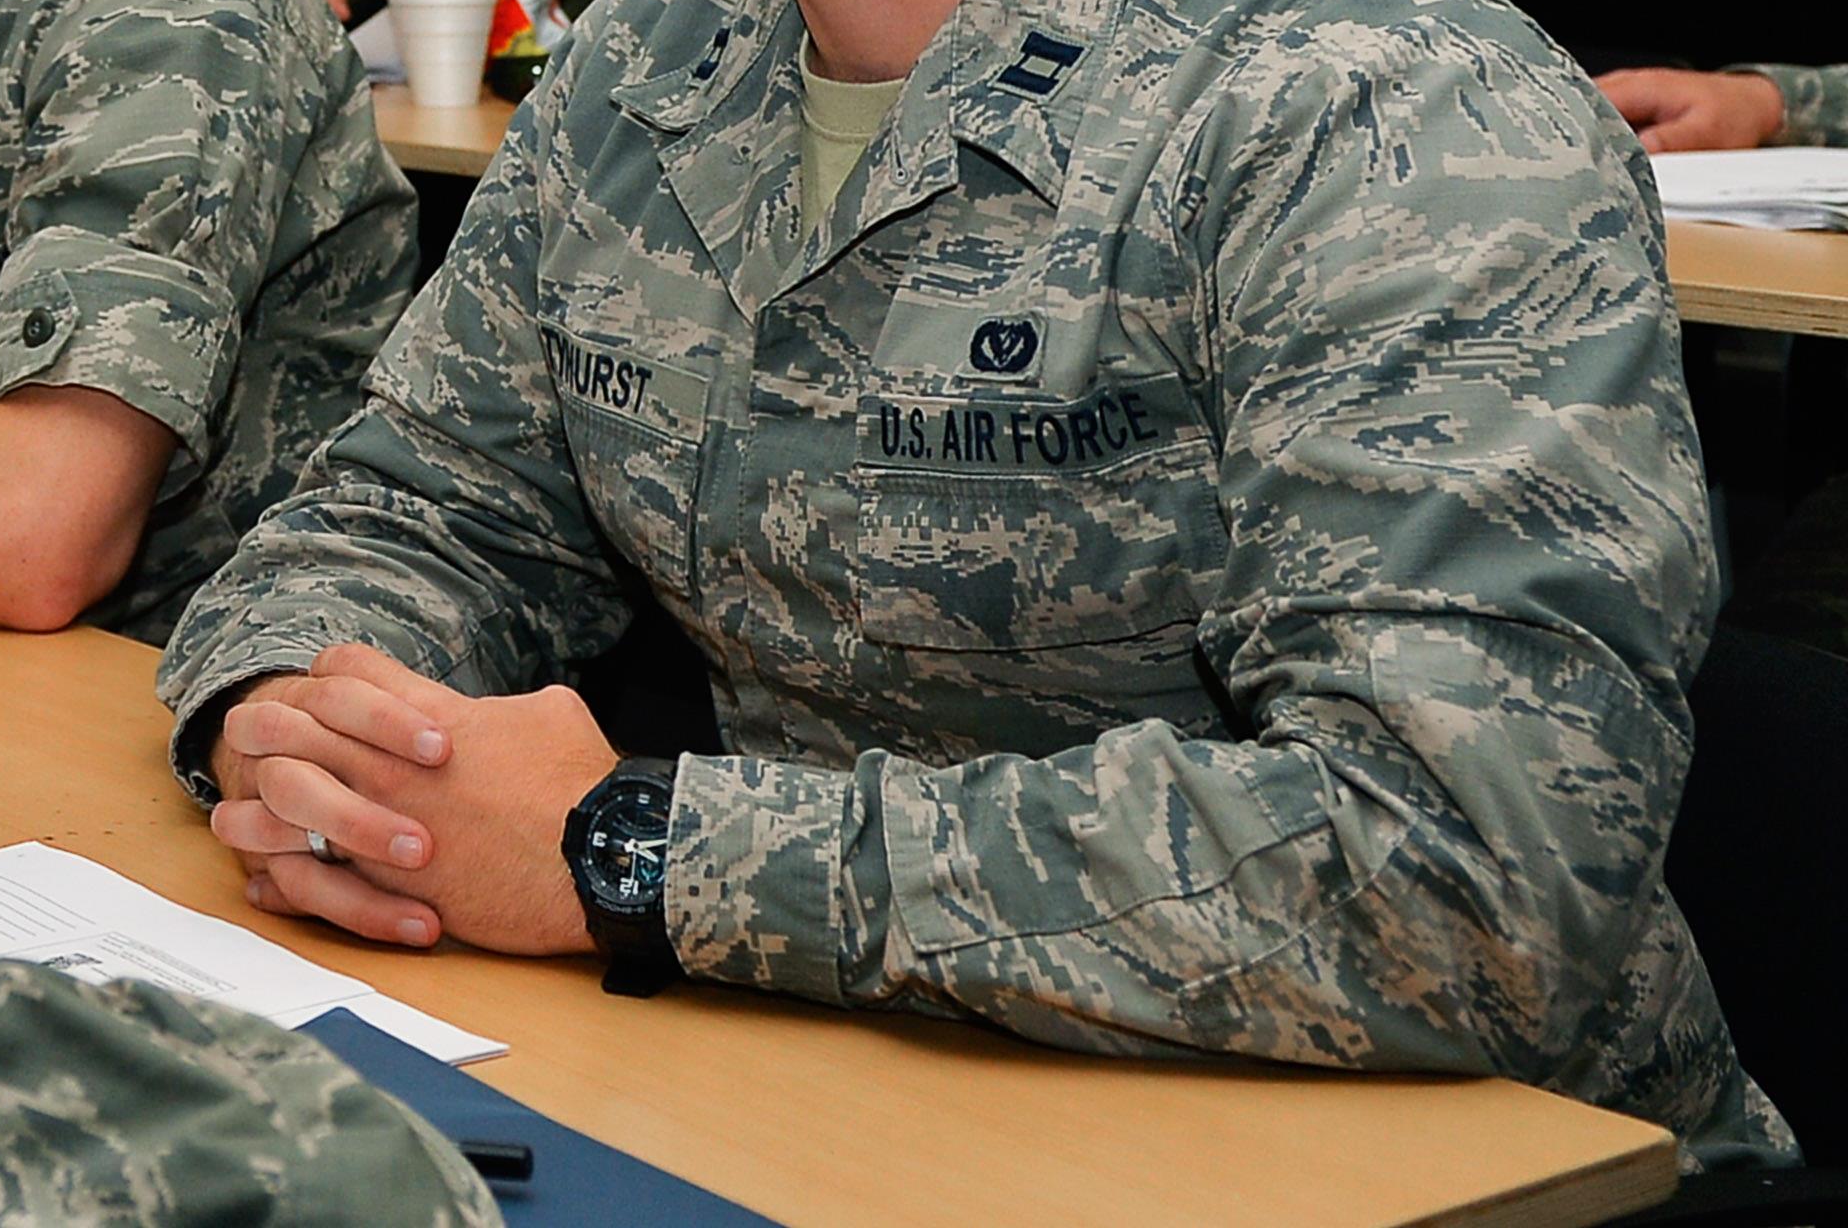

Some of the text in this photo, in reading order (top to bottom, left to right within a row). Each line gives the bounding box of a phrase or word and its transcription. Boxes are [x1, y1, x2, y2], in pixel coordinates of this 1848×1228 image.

[880, 392, 1159, 466] U.S. AIR FORCE
